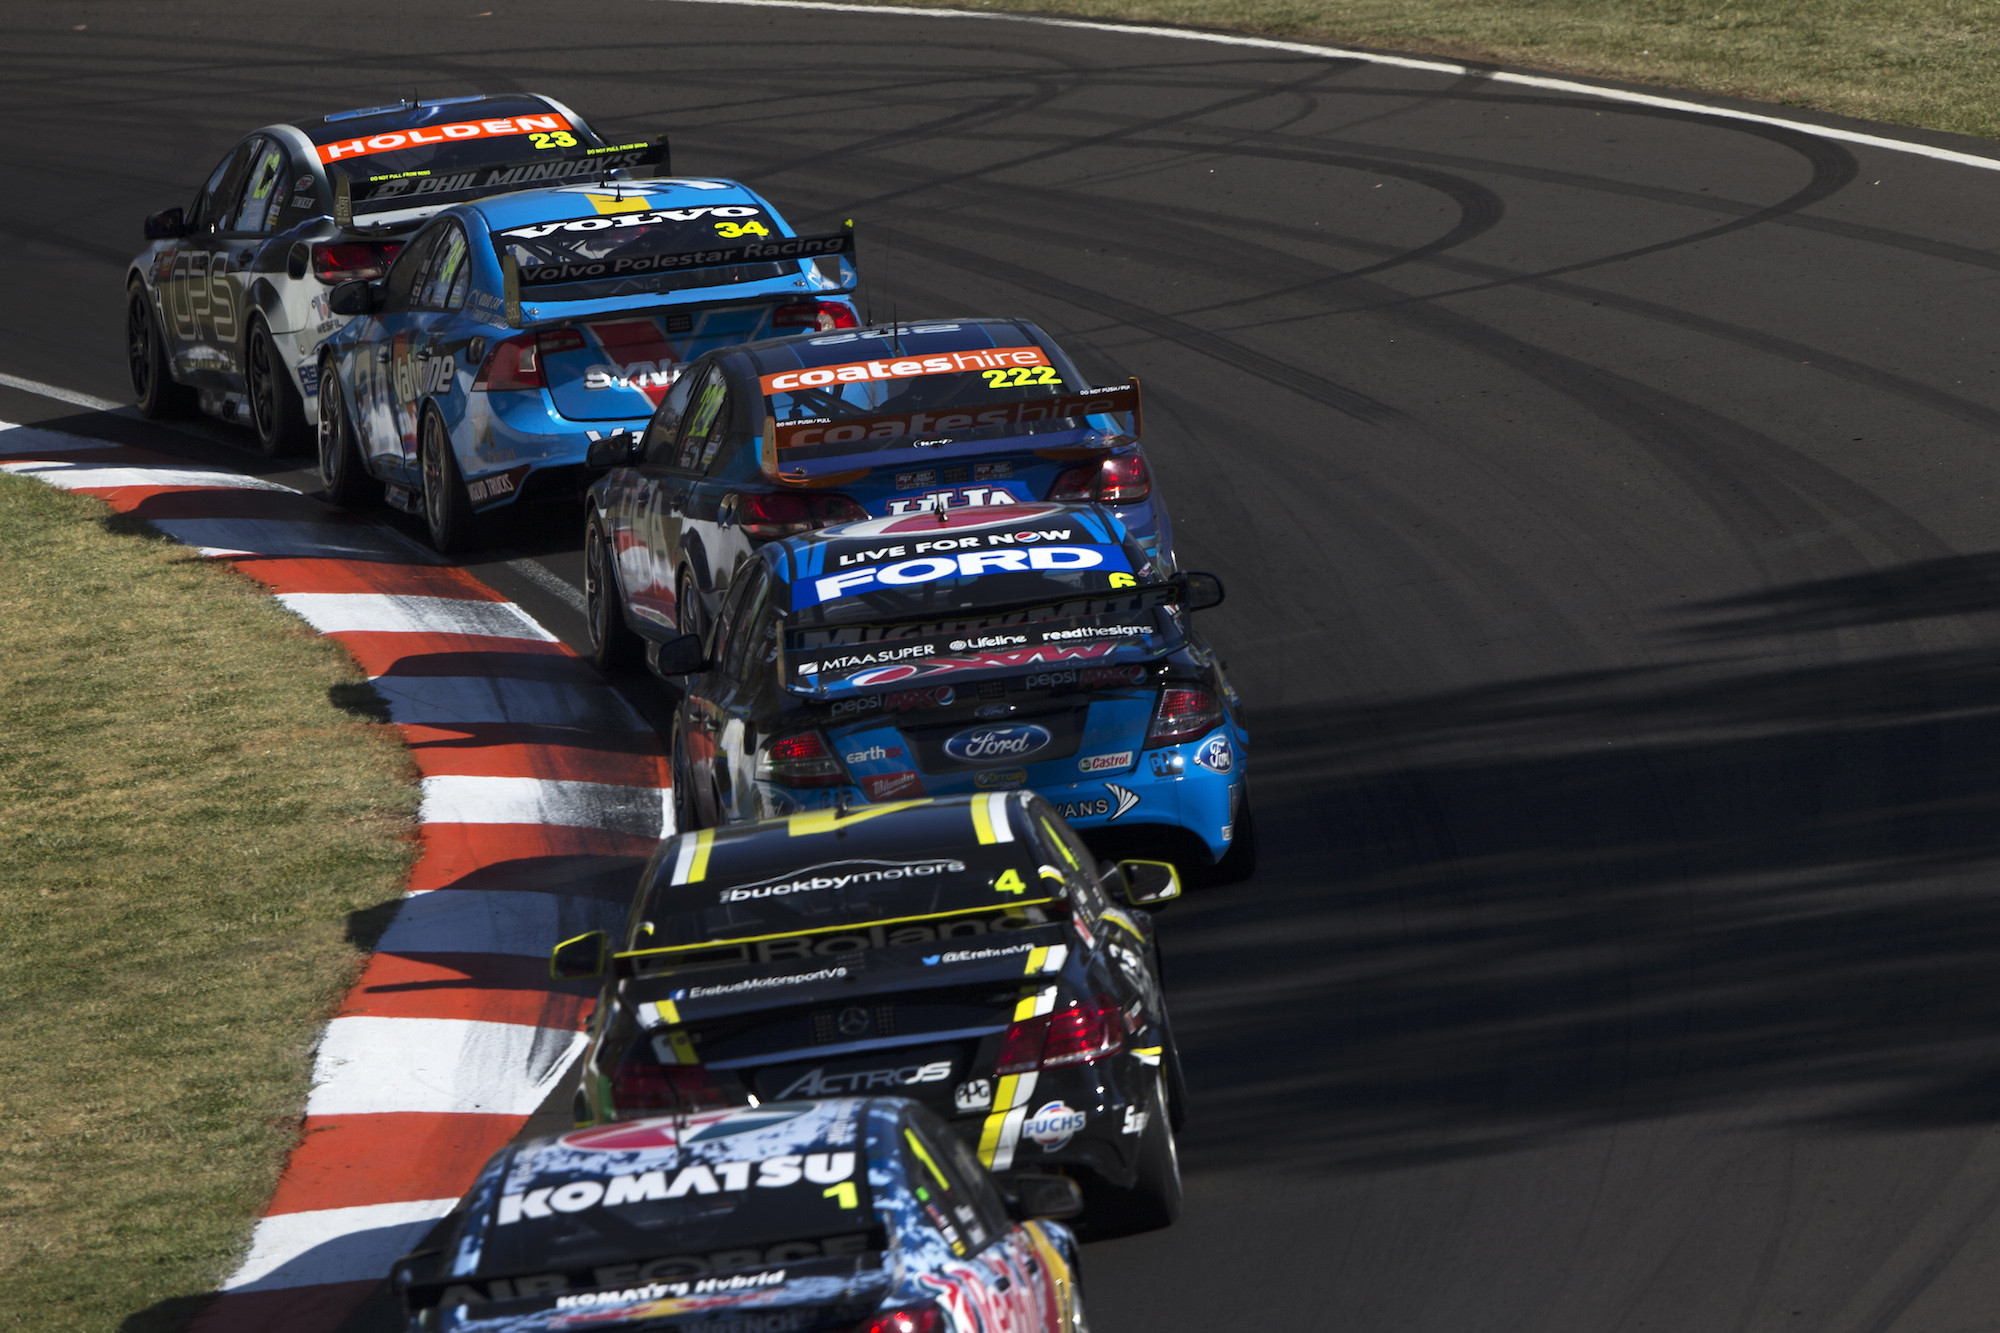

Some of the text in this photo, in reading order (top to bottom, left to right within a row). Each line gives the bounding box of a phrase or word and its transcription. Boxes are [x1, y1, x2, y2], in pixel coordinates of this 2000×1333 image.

[328, 116, 560, 159] HOLDEN
[529, 131, 578, 151] 23
[415, 172, 478, 194] PHIL
[501, 206, 760, 240] VOLVO
[714, 221, 768, 239] 34
[521, 237, 844, 283] Volvo Polestar Racing
[982, 366, 1062, 390] 222
[839, 544, 905, 568] LIVE
[915, 536, 980, 555] FOR
[815, 546, 1103, 603] FORD
[967, 633, 1028, 650] Lifeline
[1024, 668, 1078, 690] pepsi
[830, 686, 938, 718] pepsi MAX
[965, 728, 1031, 758] Ford
[1092, 753, 1131, 769] Castrol
[993, 868, 1026, 894] 4
[1025, 1114, 1085, 1136] FUCHS
[497, 1151, 856, 1226] KOMATSU
[822, 1181, 859, 1210] 1
[694, 1268, 787, 1295] Hybrid
